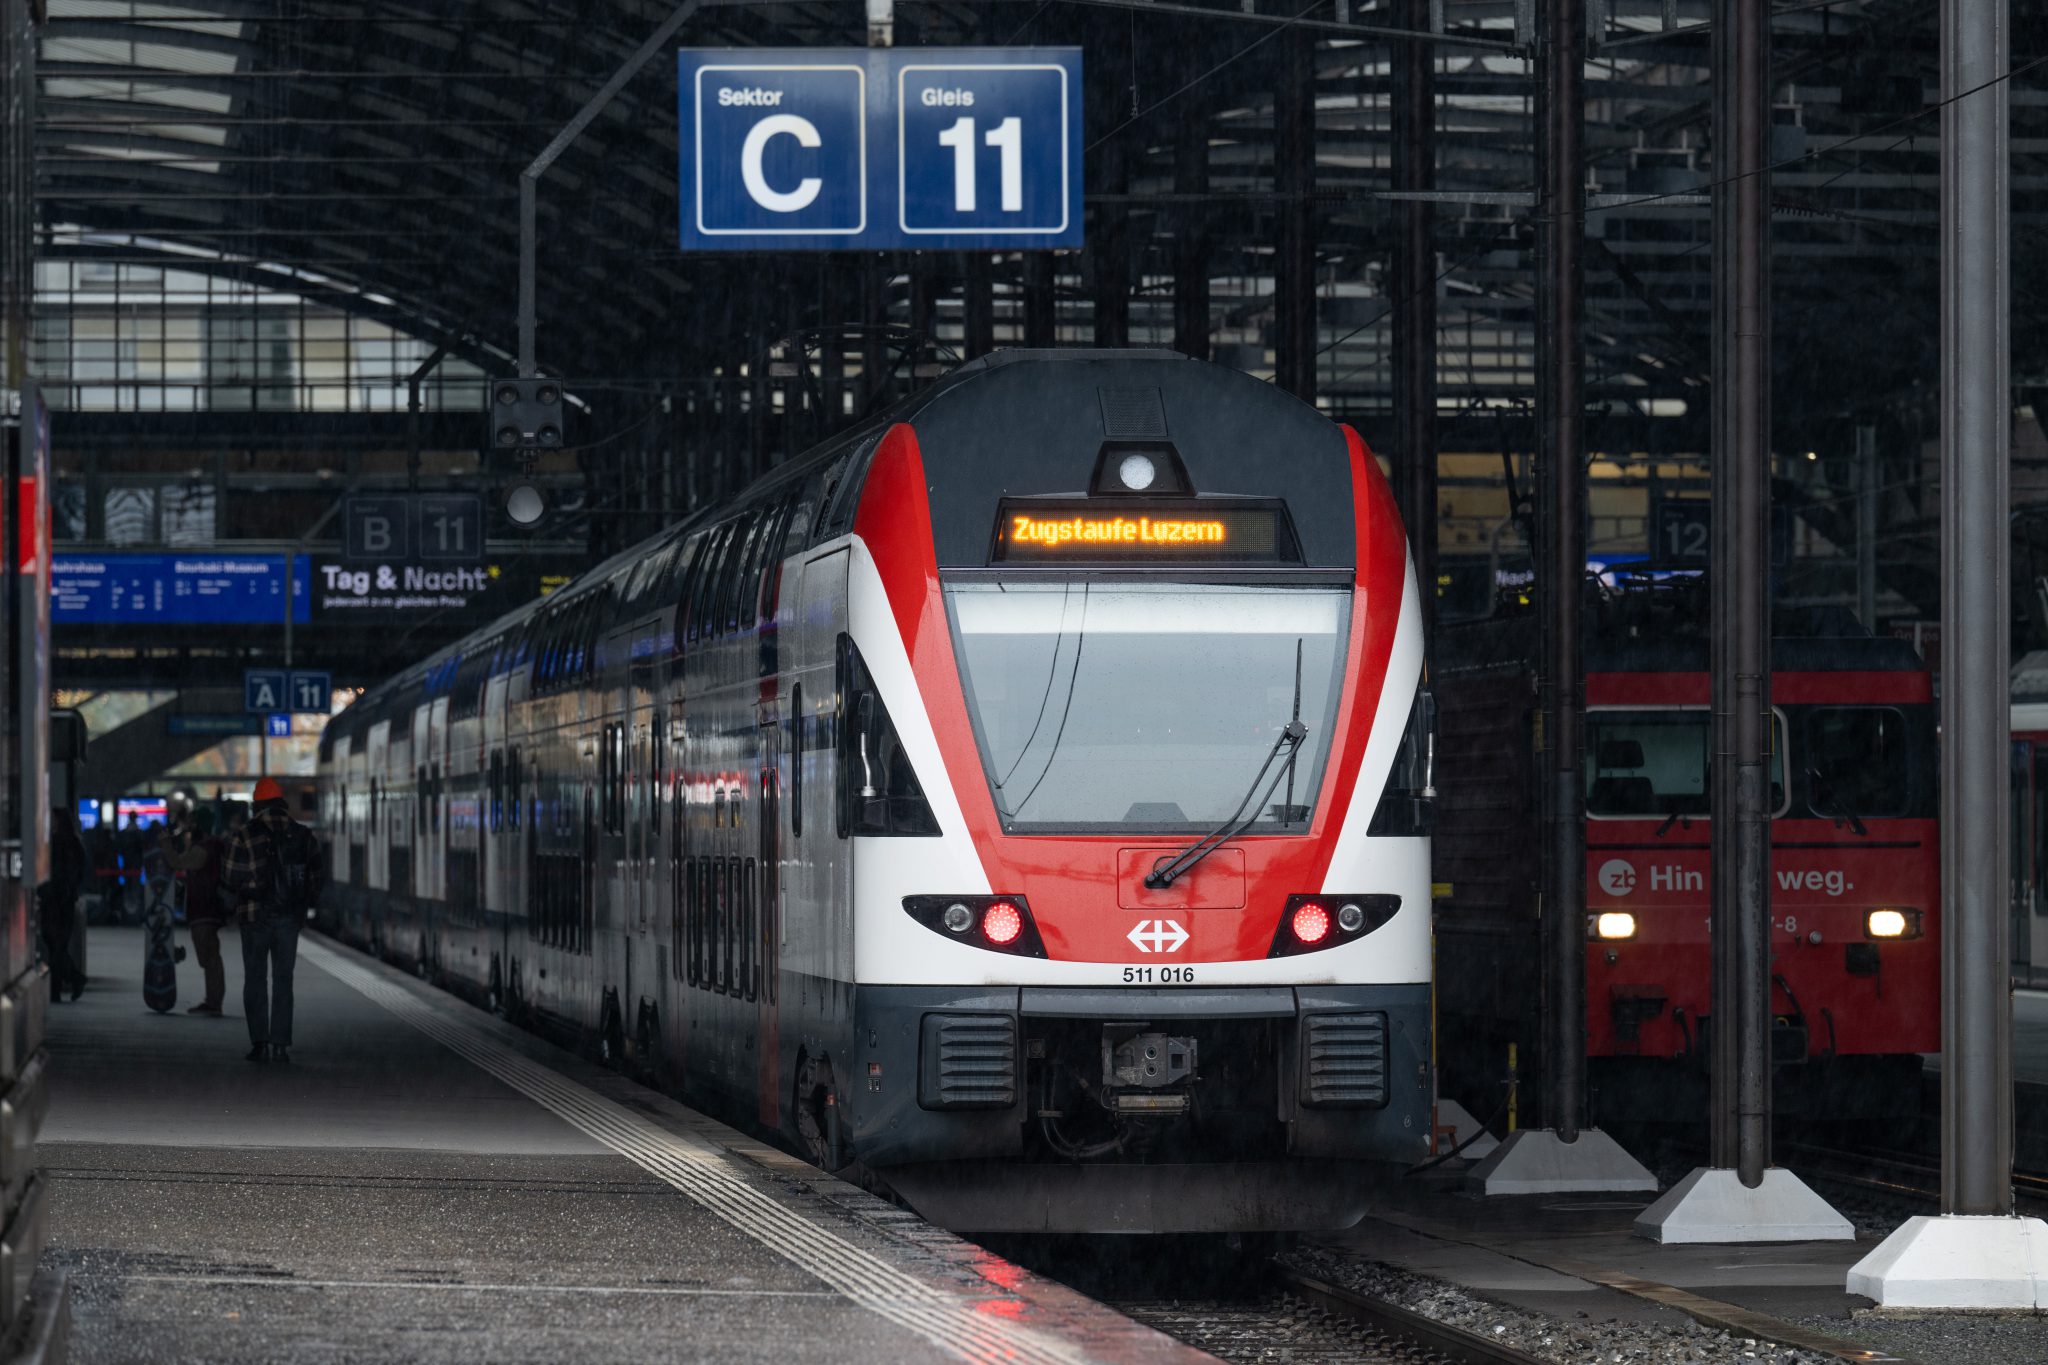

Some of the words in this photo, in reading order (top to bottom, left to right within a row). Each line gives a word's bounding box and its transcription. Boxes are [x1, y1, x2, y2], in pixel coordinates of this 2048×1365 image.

[718, 87, 783, 107] Sektor
[921, 87, 974, 107] Gleis
[741, 113, 823, 213] C
[938, 116, 1023, 212] 11
[364, 516, 392, 551] B
[433, 516, 465, 551] 11
[1013, 517, 1136, 545] Zugstaufe
[1139, 518, 1226, 542] Luzern
[1665, 521, 1708, 556] 12
[321, 564, 371, 595] Tag
[375, 564, 398, 591] &
[255, 683, 277, 708] A
[298, 683, 321, 708] 11
[1610, 866, 1637, 888] zb
[1650, 865, 1704, 891] Hin
[1776, 868, 1854, 897] weg.
[1122, 967, 1152, 983] 511
[1160, 967, 1194, 983] 016
